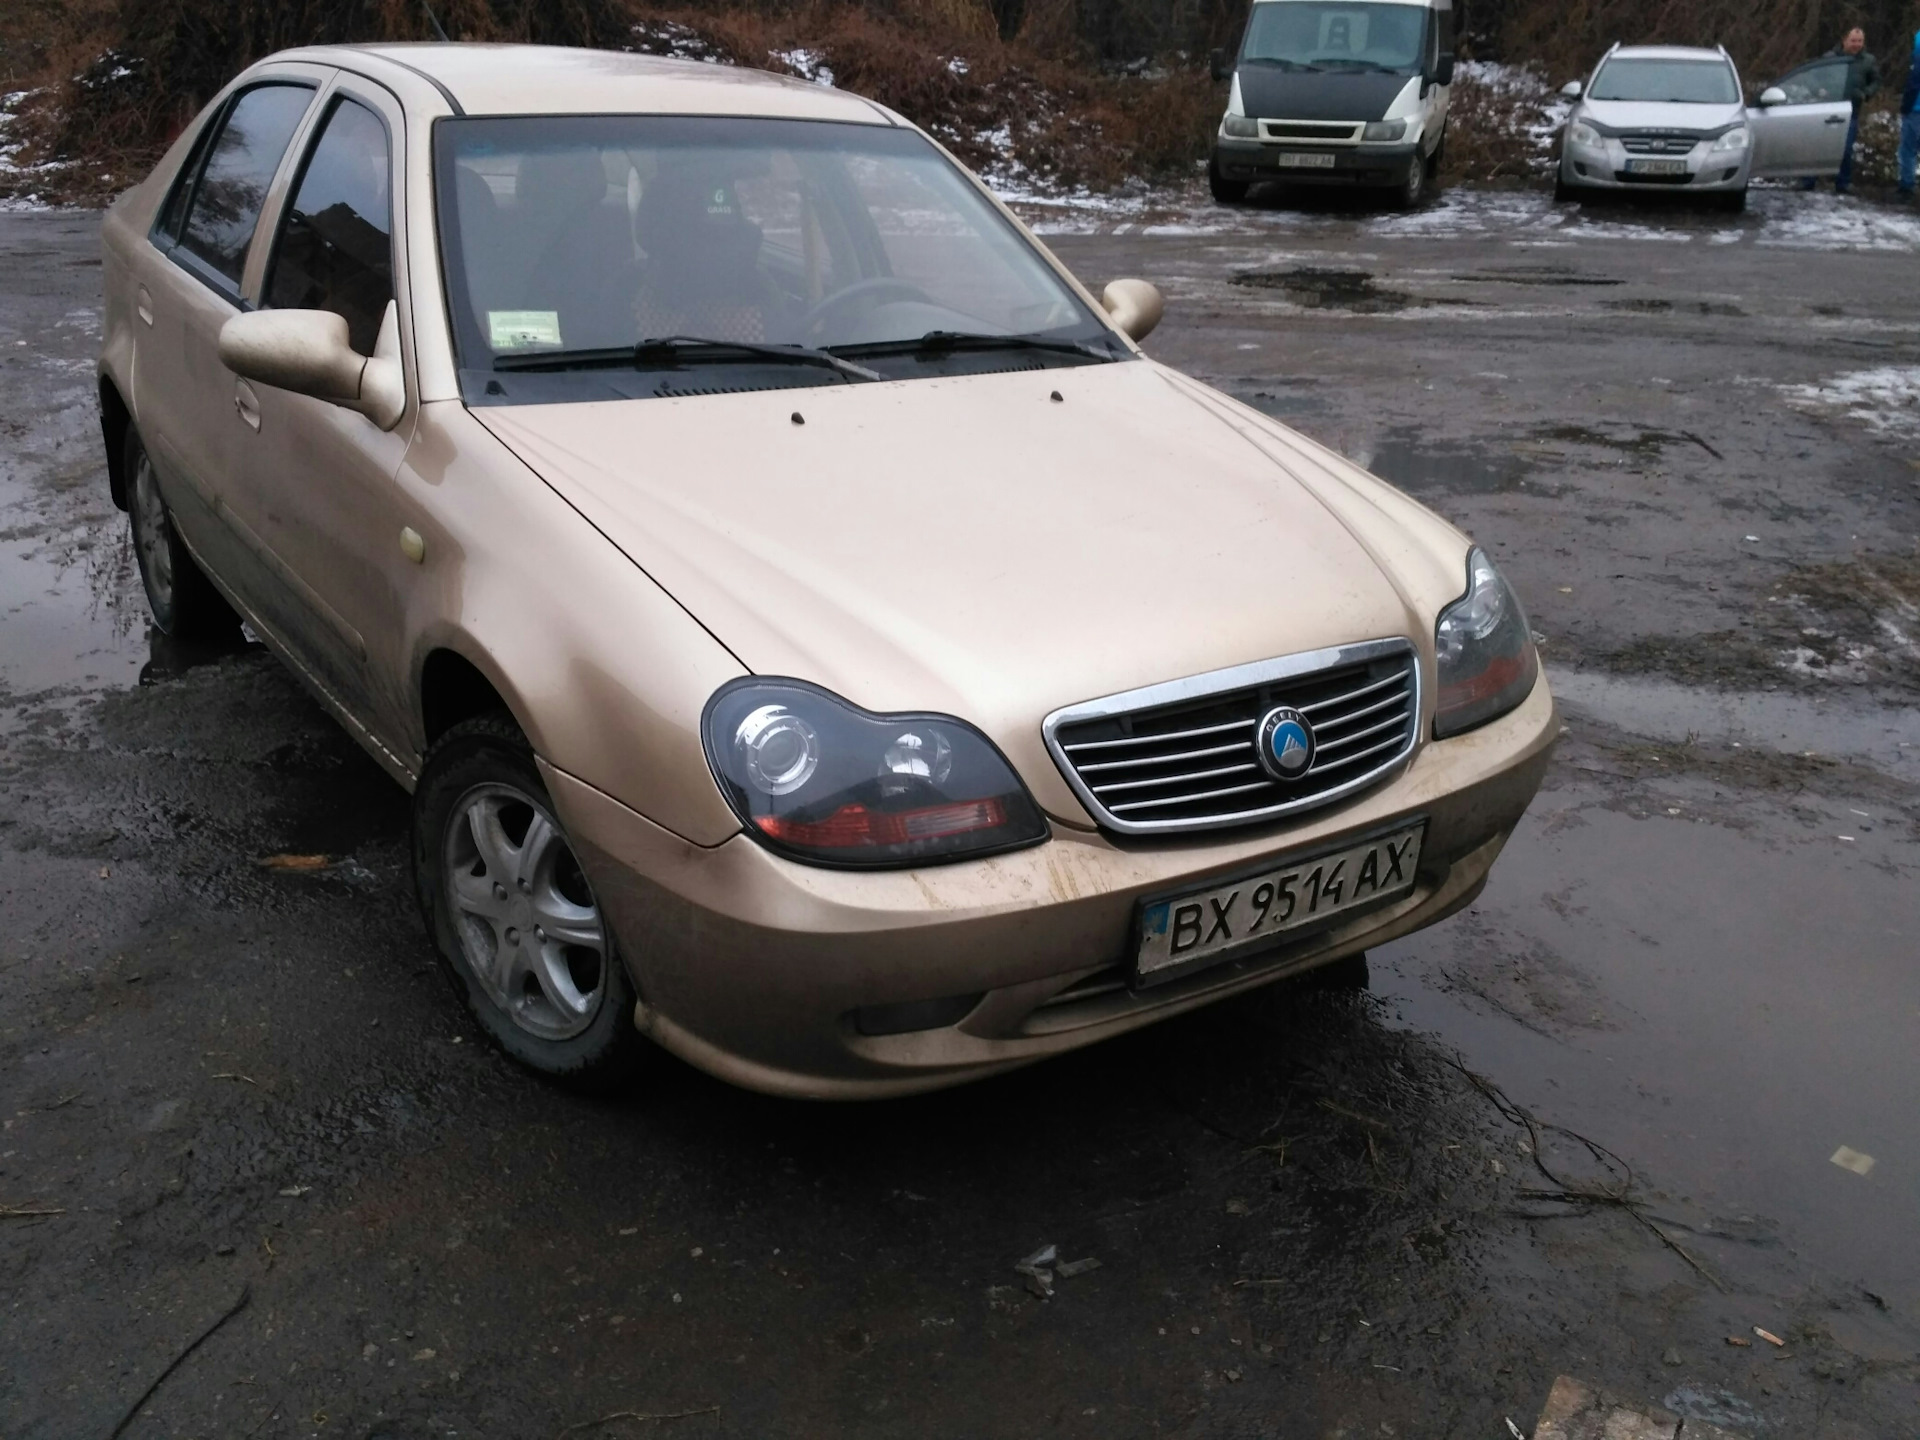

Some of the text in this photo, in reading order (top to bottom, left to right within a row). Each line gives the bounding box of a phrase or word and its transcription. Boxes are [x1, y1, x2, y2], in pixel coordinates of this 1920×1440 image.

[1266, 711, 1301, 732] GEELY
[1170, 837, 1411, 955] BX 9514 AX
